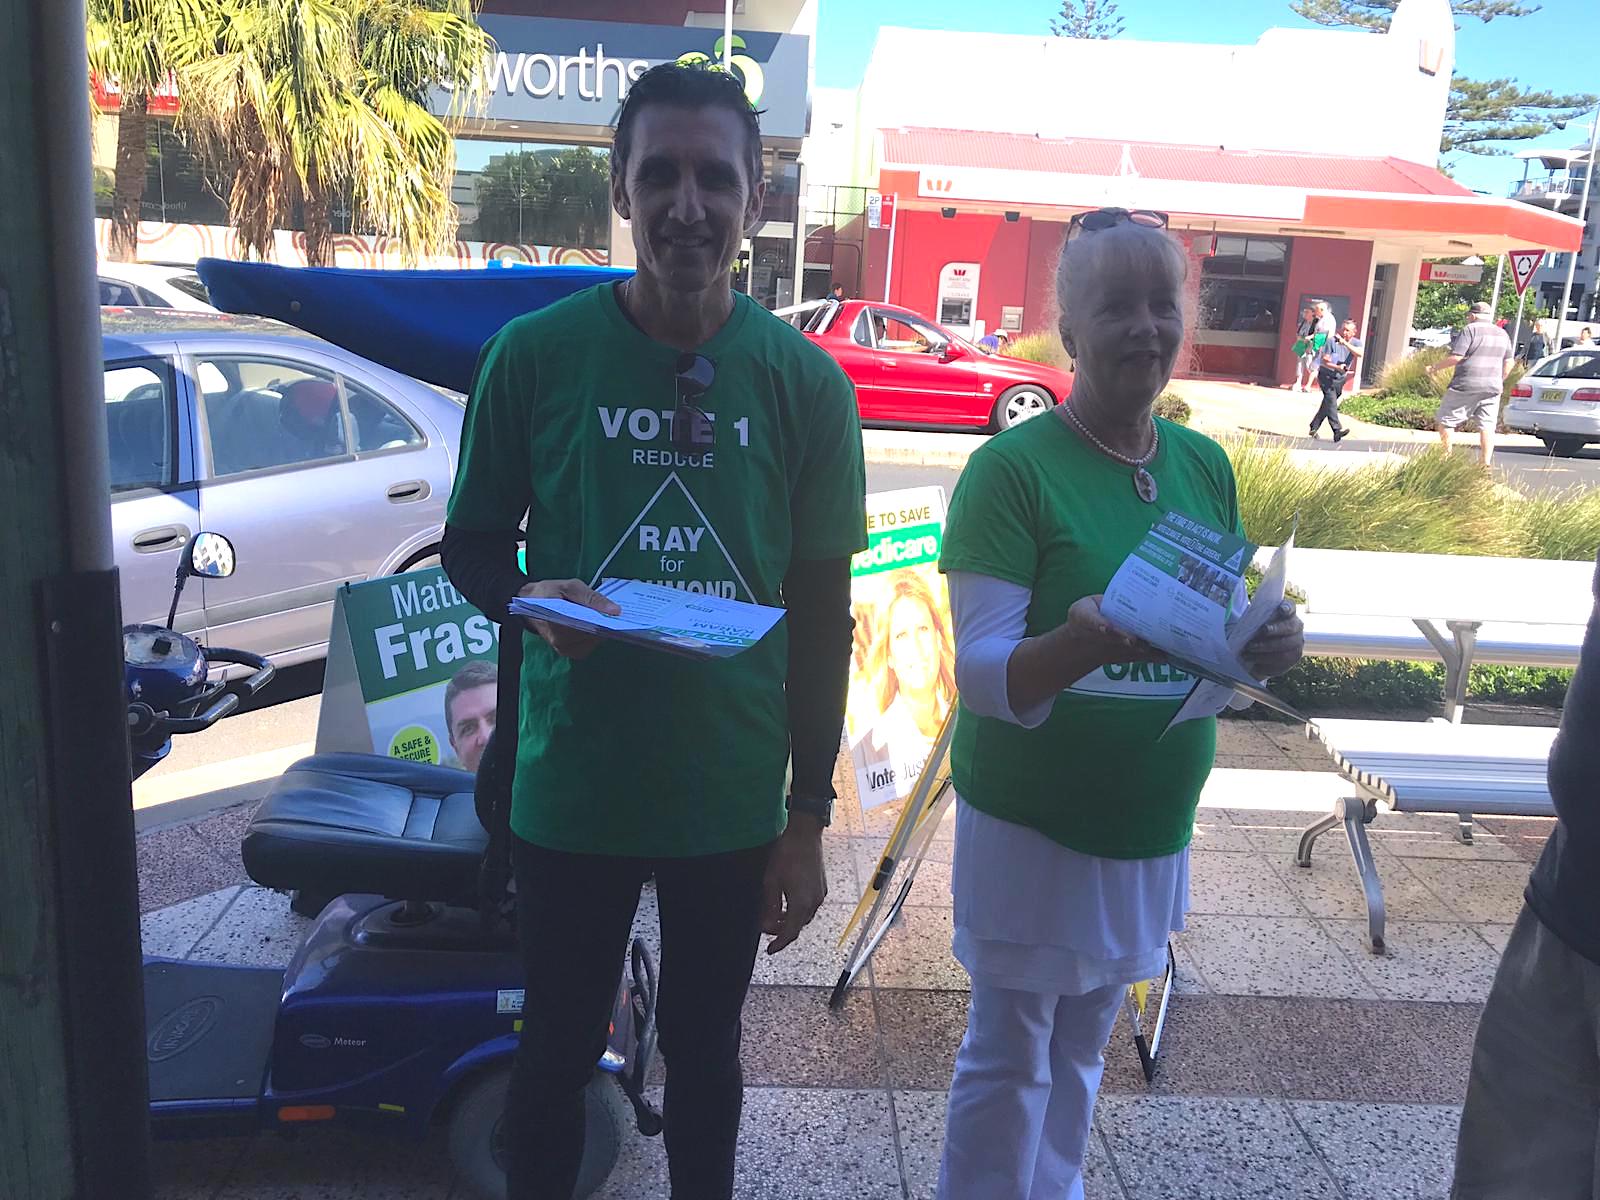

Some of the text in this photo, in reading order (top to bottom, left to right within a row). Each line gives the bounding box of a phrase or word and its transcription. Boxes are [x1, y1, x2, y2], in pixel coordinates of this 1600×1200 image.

[440, 43, 649, 98] worths
[598, 406, 750, 447] VOTE 1
[879, 512, 896, 527] TO
[899, 506, 931, 524] SAVE
[639, 525, 705, 552] RAY
[660, 556, 684, 573] for
[391, 576, 467, 619] Matt
[394, 735, 431, 756] A SAFE &
[866, 758, 926, 789] Vote Jus
[334, 1037, 367, 1047] Meteor
